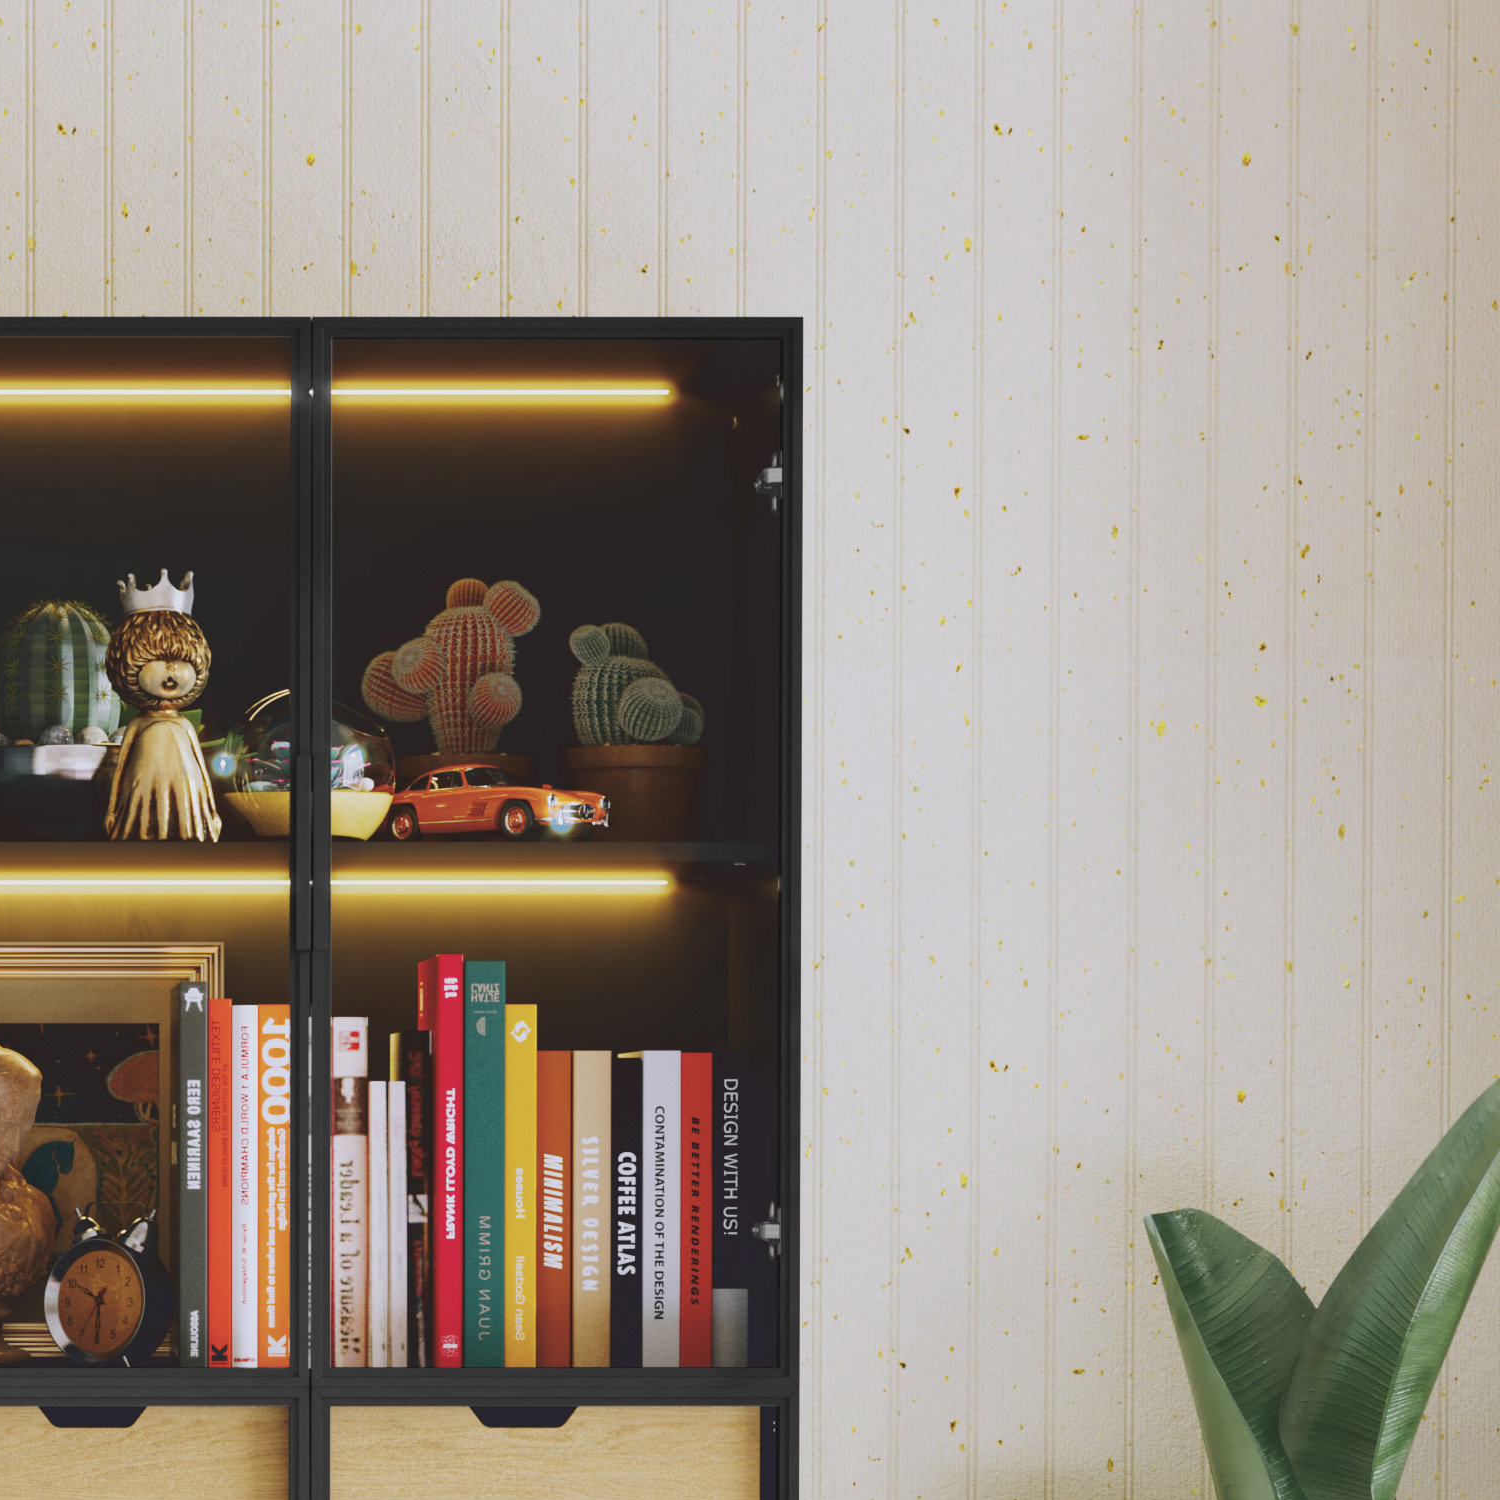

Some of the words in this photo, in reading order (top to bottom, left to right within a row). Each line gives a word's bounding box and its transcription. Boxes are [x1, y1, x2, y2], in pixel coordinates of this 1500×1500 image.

[691, 1117, 700, 1135] BE
[723, 1078, 738, 1146] DESIGN
[581, 1136, 599, 1206] SILVER
[655, 1106, 665, 1217] CONTAMINATION
[691, 1142, 700, 1197] BETTER
[723, 1153, 738, 1199] WITH
[617, 1151, 636, 1215] COFFEE
[543, 1153, 563, 1270] MINIMALISM
[655, 1221, 665, 1238] OF
[723, 1206, 738, 1235] US!
[96, 1259, 105, 1268] 12
[581, 1217, 599, 1291] DESIGN
[617, 1221, 636, 1276] ATLAS
[655, 1242, 665, 1267] THE
[691, 1205, 700, 1306] RENDERINGS
[80, 1265, 88, 1273] 11
[125, 1277, 130, 1286] 2
[65, 1298, 70, 1307] 9
[128, 1298, 133, 1307] 3
[655, 1271, 665, 1319] DESIGN
[110, 1330, 116, 1339] 5
[122, 1316, 128, 1324] 4
